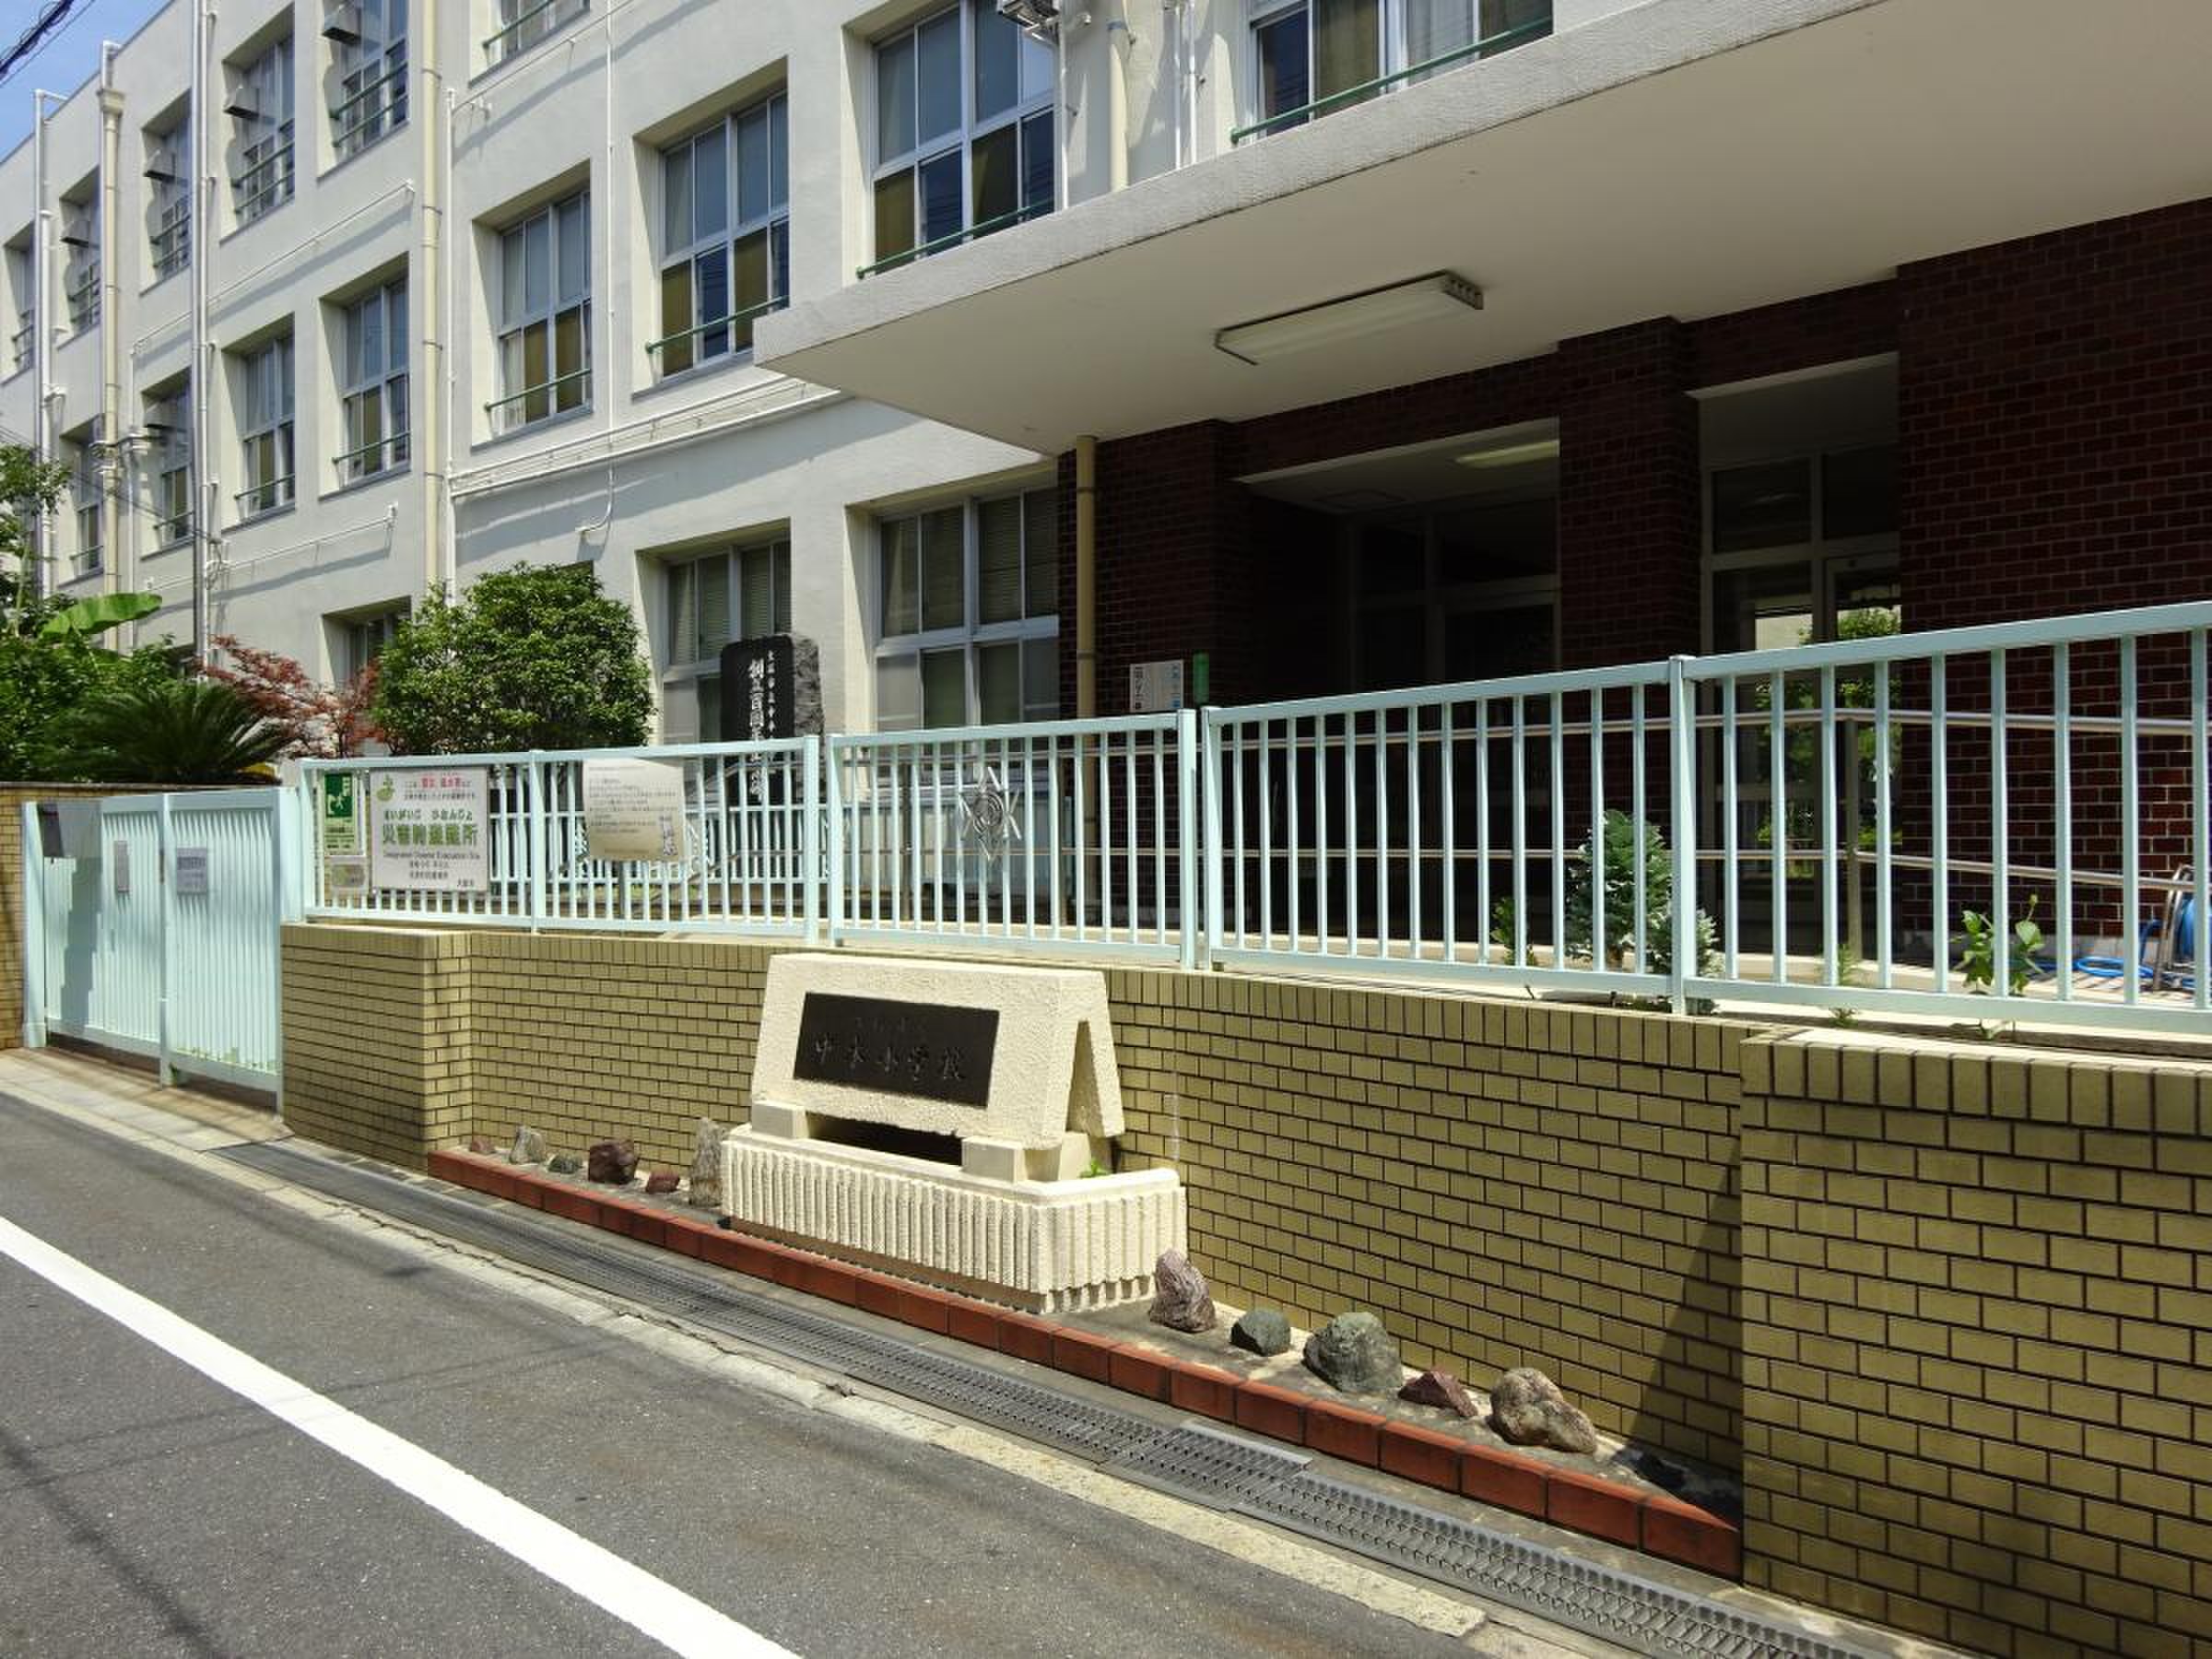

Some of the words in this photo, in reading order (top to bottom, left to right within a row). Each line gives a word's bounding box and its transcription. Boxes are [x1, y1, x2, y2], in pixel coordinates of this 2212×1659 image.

[383, 823, 478, 845] 災害時避難所
